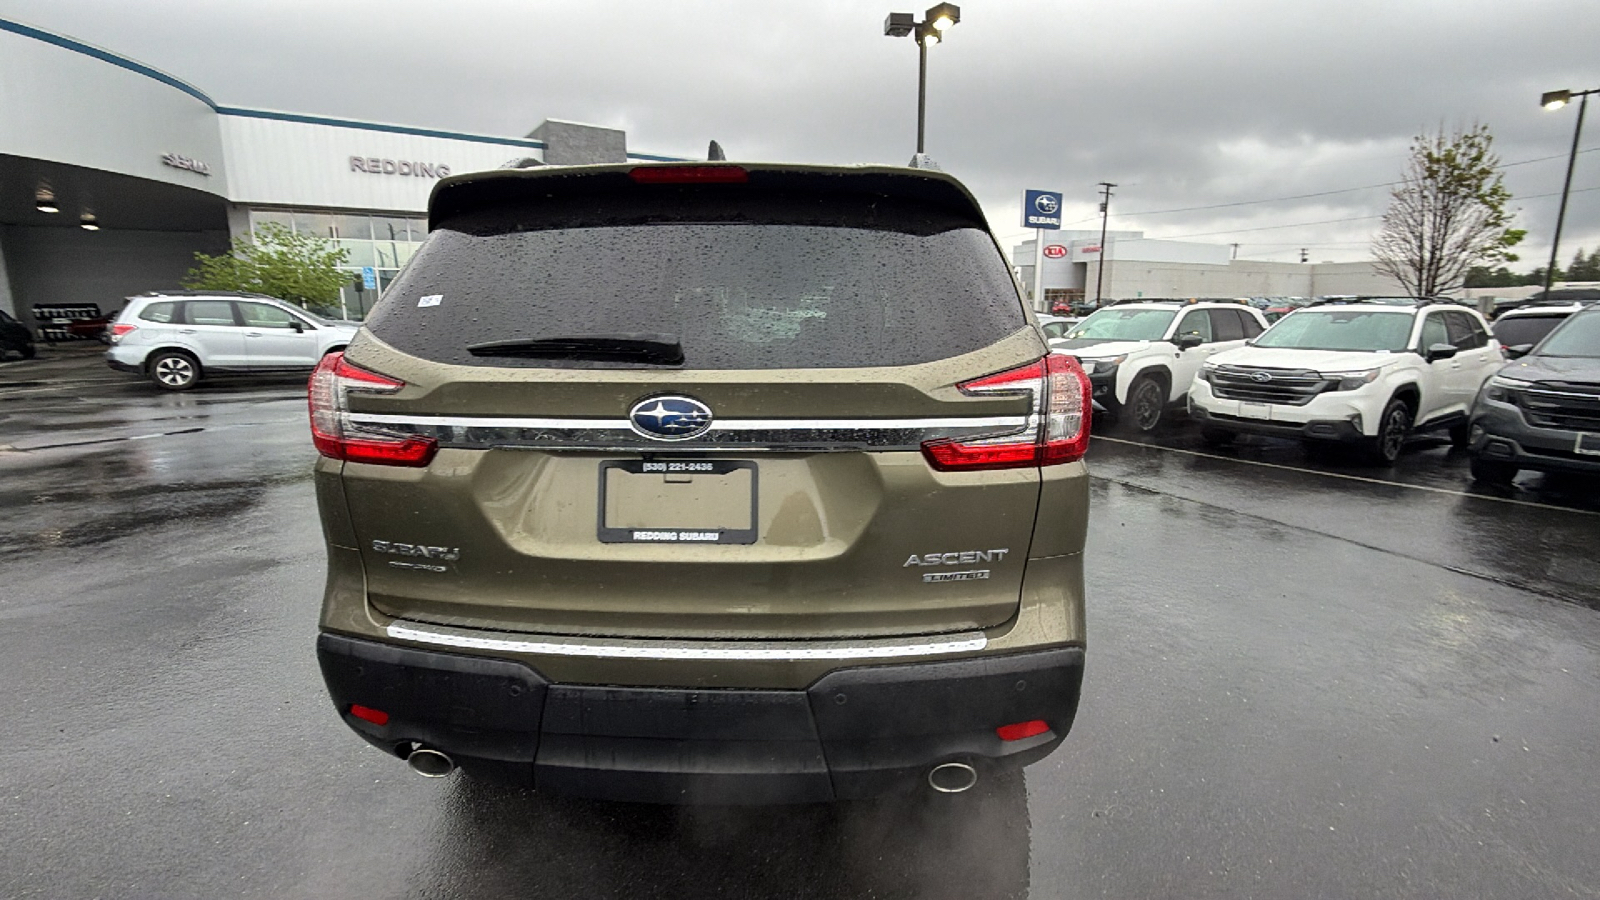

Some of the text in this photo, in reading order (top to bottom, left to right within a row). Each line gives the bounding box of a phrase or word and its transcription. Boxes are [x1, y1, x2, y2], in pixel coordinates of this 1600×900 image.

[349, 156, 451, 179] REDDING
[1028, 215, 1060, 226] SUBARU
[642, 462, 667, 472] (530)
[633, 531, 719, 541] REDDING SUBARU
[372, 539, 460, 561] SUBARU
[902, 548, 1009, 567] ASCENT
[929, 571, 986, 581] LIMITED
